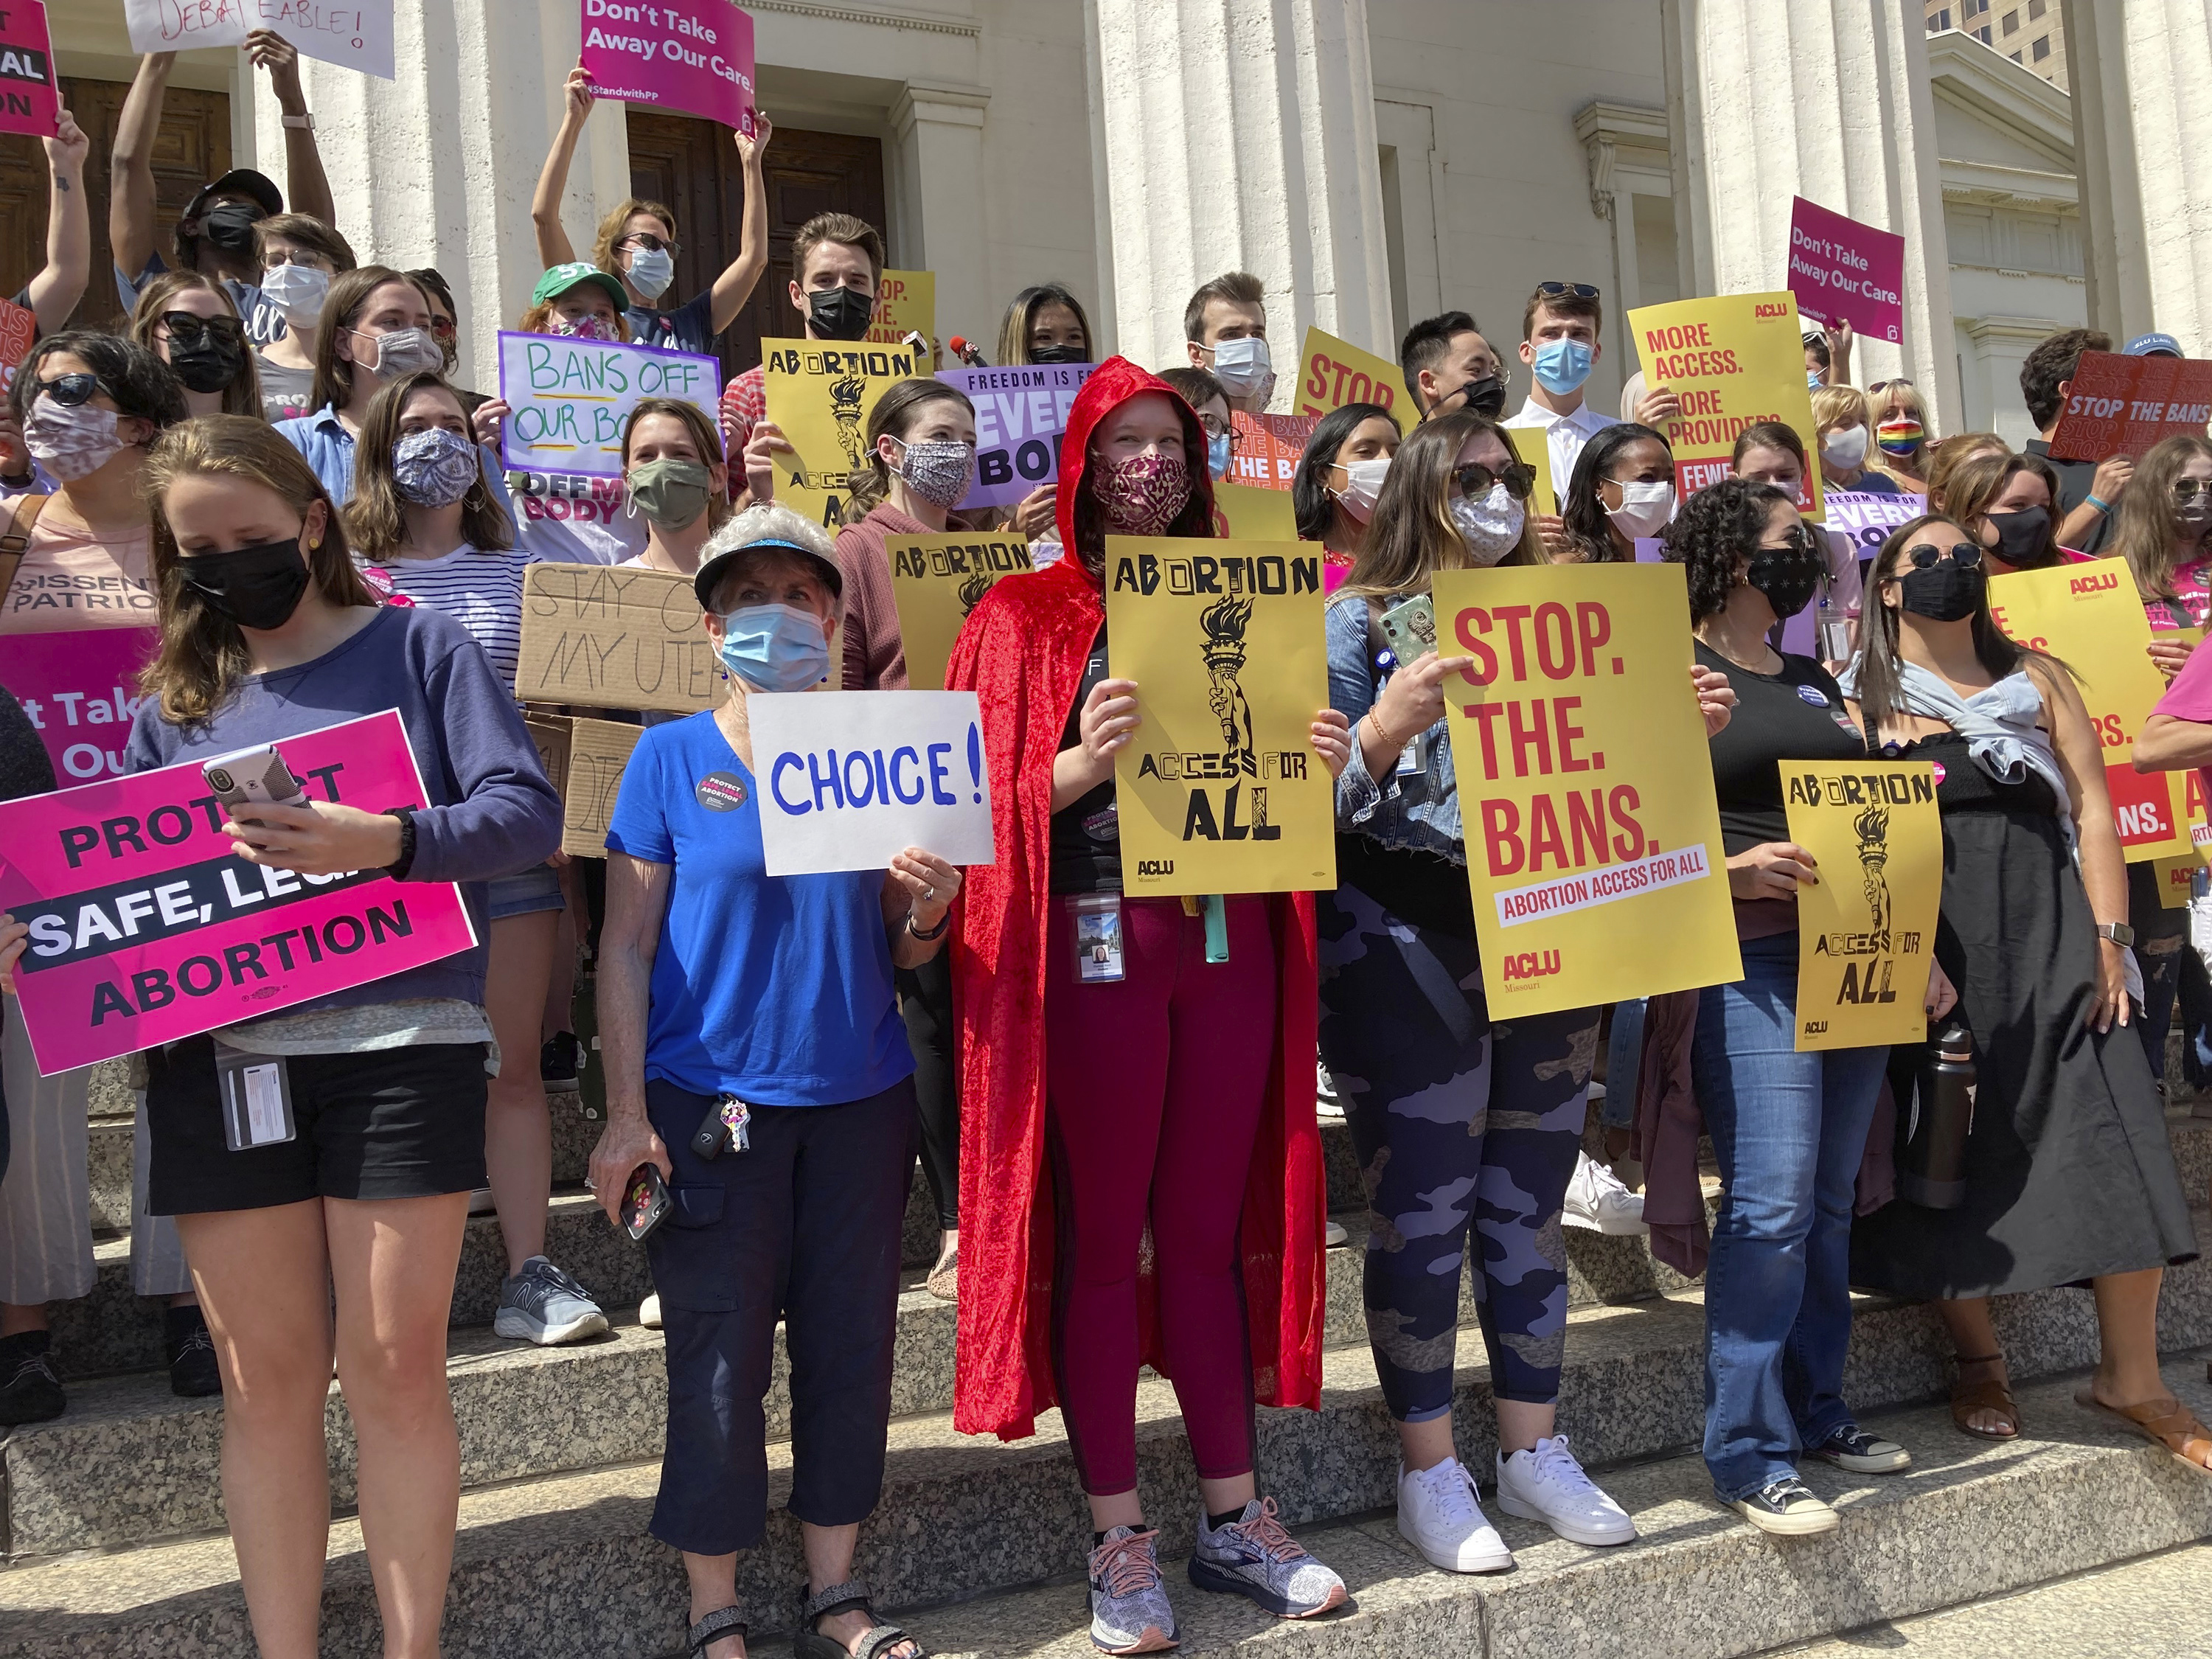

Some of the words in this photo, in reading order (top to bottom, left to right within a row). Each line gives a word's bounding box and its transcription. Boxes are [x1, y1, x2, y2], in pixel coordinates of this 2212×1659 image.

[587, 0, 658, 27] Don't
[664, 9, 717, 44] Take
[585, 27, 657, 60] Away
[663, 40, 706, 68] Our
[710, 55, 754, 94] Care.
[1792, 226, 1832, 259] Don't
[1834, 243, 1868, 271] Take
[881, 279, 908, 302] OP.
[1790, 254, 1829, 287] Away
[1832, 270, 1859, 293] Our
[1862, 280, 1902, 306] Care.
[1755, 303, 1787, 318] ACLU
[1797, 304, 1827, 321] andwithPP
[1646, 323, 1712, 353] MORE
[2133, 338, 2151, 349] SLU
[526, 342, 628, 394] BANS
[639, 361, 700, 394] OFF
[768, 349, 913, 378] ABORTION
[1656, 349, 1743, 380] ACCESS.
[968, 371, 1045, 390] FREEDOM
[1054, 371, 1069, 385] IS
[515, 403, 591, 444] OUR
[2067, 395, 2124, 418] STOP
[2129, 401, 2165, 422] THE
[2165, 403, 2211, 423] BANS
[789, 472, 847, 490] ACCE
[524, 496, 622, 525] BODY
[1825, 495, 1872, 504] REEDOM
[895, 543, 1032, 578] ABORTION
[1113, 554, 1319, 597] ABORTION
[532, 567, 639, 619] STAY
[2070, 573, 2118, 594] ACLU
[13, 592, 157, 613] PATRIO
[540, 630, 627, 689] MY
[1454, 601, 1624, 686] STOP.
[52, 687, 142, 726] Tak
[1464, 696, 1606, 782] THE.
[63, 743, 125, 779] Ou
[1138, 746, 1257, 784] ACCESS
[1262, 751, 1307, 781] FOR
[700, 787, 739, 803] ABORTION
[709, 777, 741, 792] PROTECT
[1790, 773, 1935, 807] ABORTION
[59, 763, 344, 869] PROTT
[1087, 810, 1113, 821] PROTEC
[1088, 816, 1117, 831] ABORTIO
[1182, 777, 1281, 841] ALL
[1480, 784, 1660, 877] BANS.
[1138, 860, 1174, 875] ACLU
[1504, 880, 1588, 920] ABORTION
[1592, 865, 1648, 899] ACCESS
[1650, 858, 1677, 883] FOR
[1680, 852, 1704, 876] ALL
[29, 880, 212, 957] SAFE,
[1815, 930, 1891, 959] ACCESS
[1892, 931, 1921, 955] FOR
[90, 900, 414, 1027] ABORTION
[1503, 948, 1561, 981] ACLU
[1836, 953, 1896, 1005] ALL
[1504, 981, 1540, 994] Missouri
[1804, 1020, 1828, 1034] ACLU
